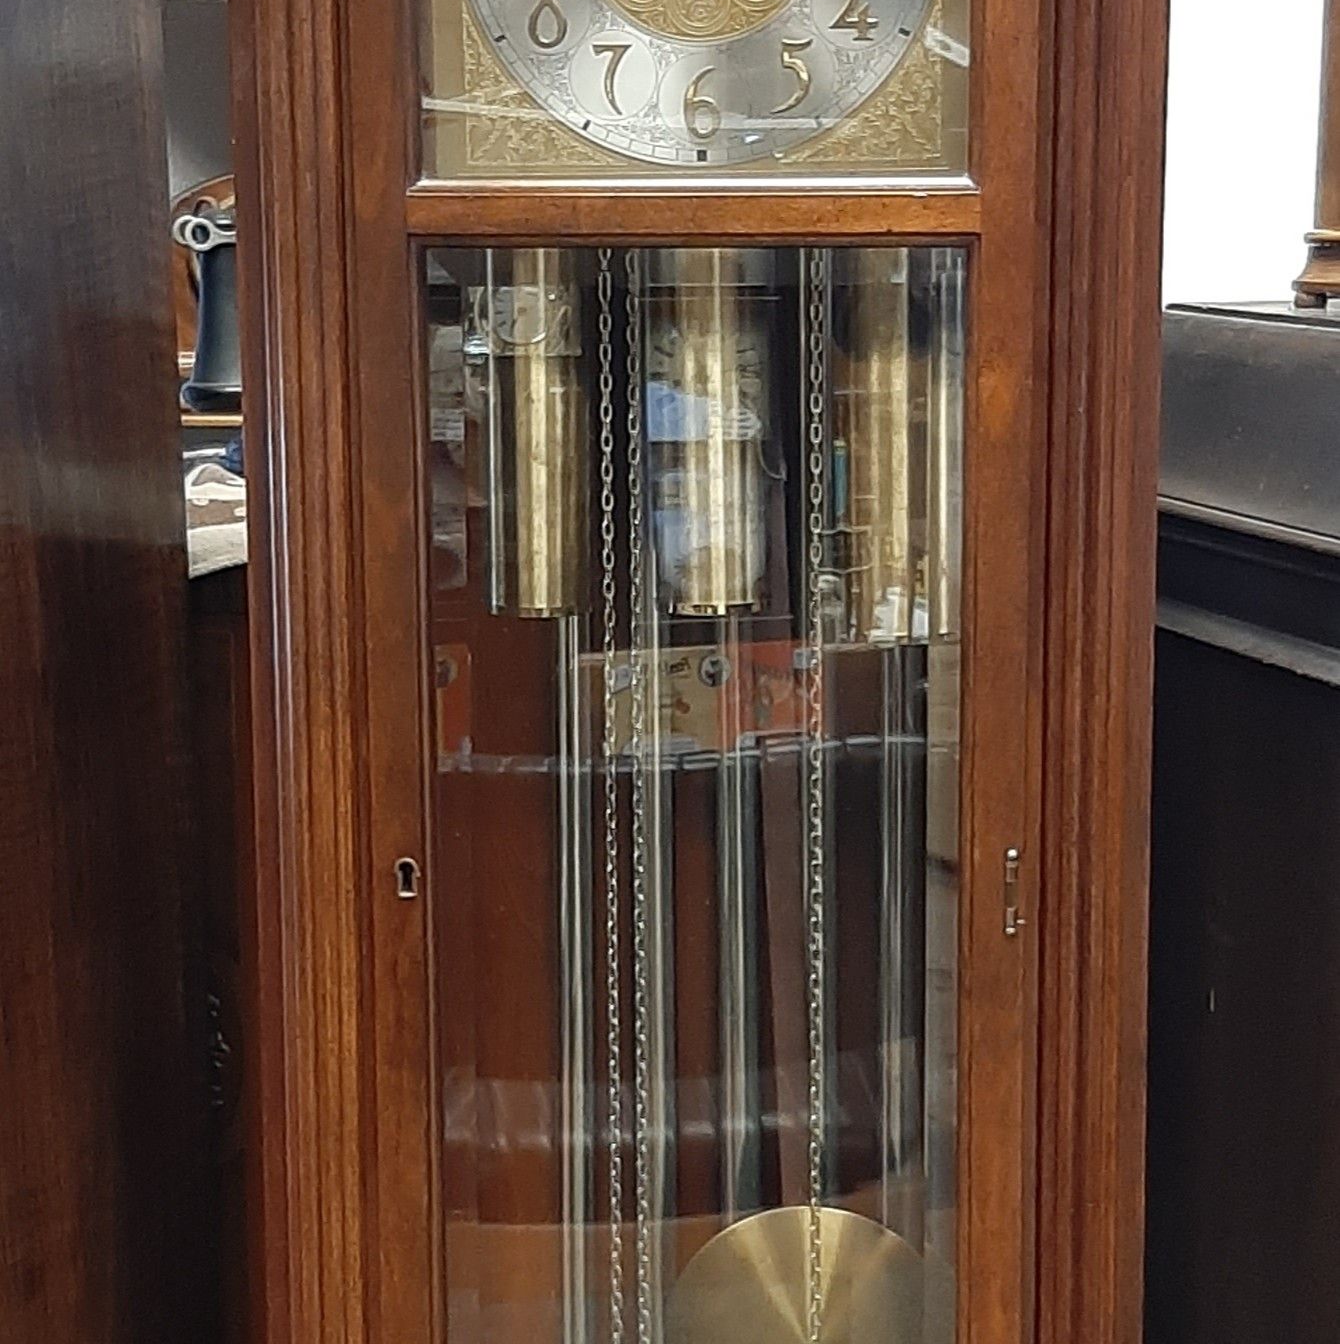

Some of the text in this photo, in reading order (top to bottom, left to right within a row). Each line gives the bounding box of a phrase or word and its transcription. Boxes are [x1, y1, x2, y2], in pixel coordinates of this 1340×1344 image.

[592, 43, 633, 116] 7
[684, 65, 721, 140] 6
[769, 38, 814, 115] 5
